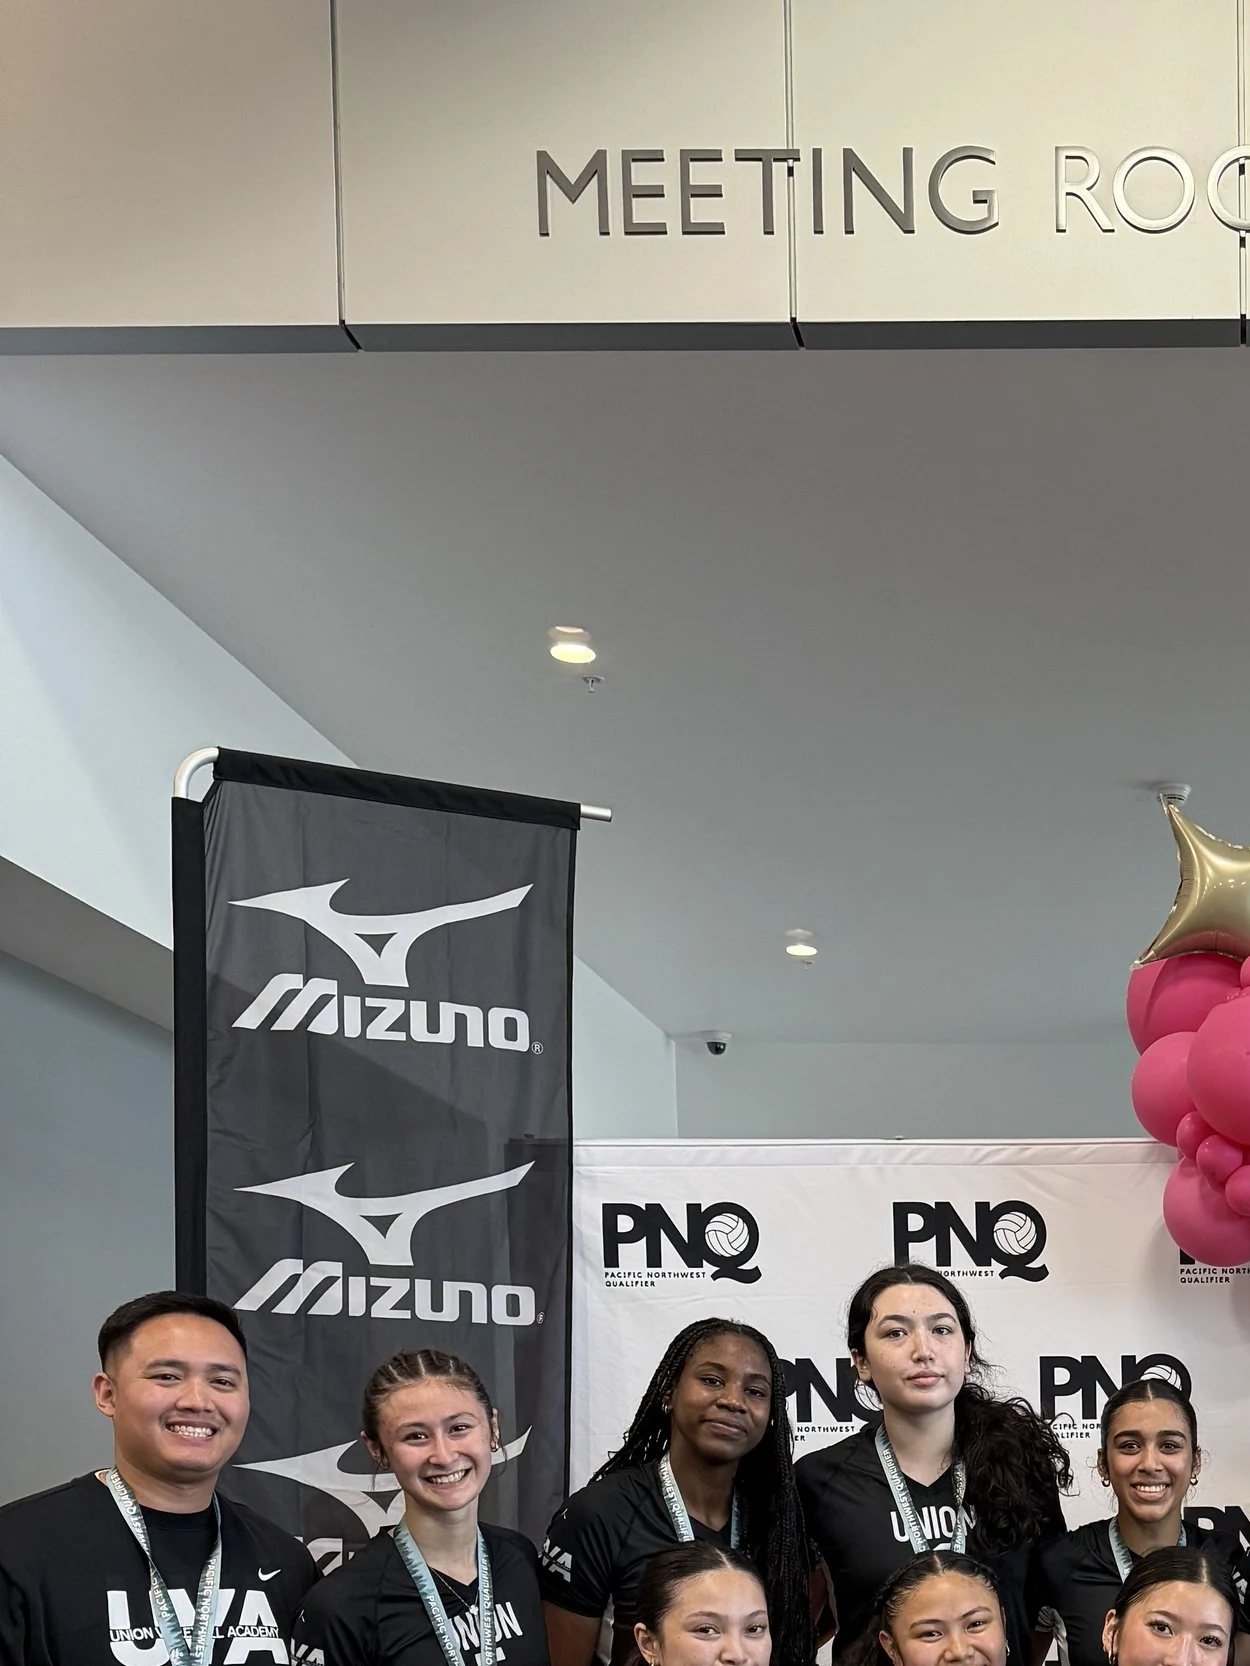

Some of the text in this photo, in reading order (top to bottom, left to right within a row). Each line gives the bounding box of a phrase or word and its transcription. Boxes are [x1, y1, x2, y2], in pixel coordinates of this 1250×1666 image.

[537, 146, 999, 235] MEETING
[602, 1201, 762, 1284] PNQ
[892, 1200, 1049, 1283] PNQ
[604, 1271, 707, 1280] PACIFIC NORTHWEST
[604, 1280, 657, 1288] QUALIFIER
[941, 1269, 995, 1278] ORTHWEST
[1180, 1268, 1218, 1276] PACIFIC
[1180, 1276, 1231, 1284] QUALIFIER
[797, 1426, 856, 1434] NORTHWEST
[882, 1448, 925, 1545] NORTHWEST QUALIFIER
[205, 1558, 217, 1597] PACIFIC
[482, 1557, 495, 1612] QUALIFIER
[427, 1595, 447, 1635] PACIFIC
[109, 1627, 154, 1642] UNION
[227, 1626, 280, 1639] ACADEMY
